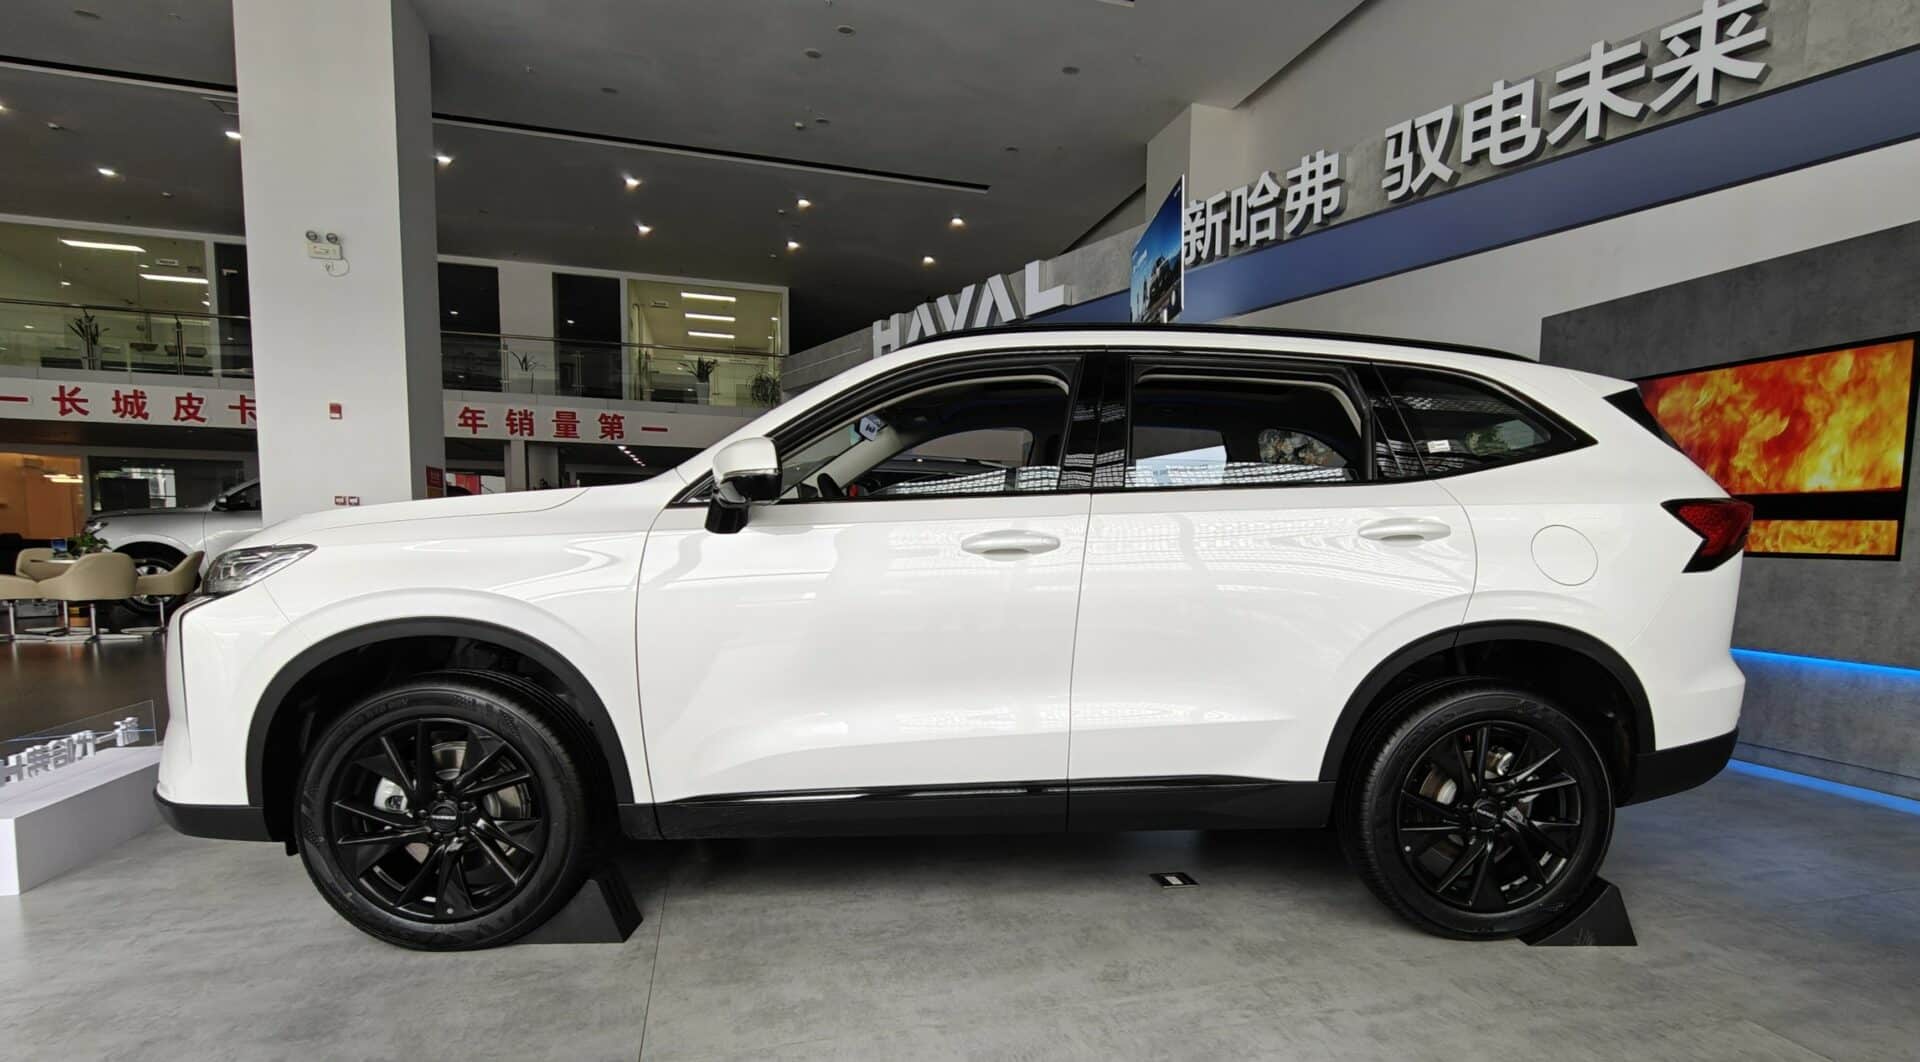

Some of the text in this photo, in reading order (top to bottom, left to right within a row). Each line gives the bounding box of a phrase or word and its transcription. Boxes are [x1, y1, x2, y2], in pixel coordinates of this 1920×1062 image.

[1184, 0, 1769, 266] 新哈弗 驭电未来
[873, 260, 1066, 359] HAVAL
[457, 406, 669, 440] 年销量第一
